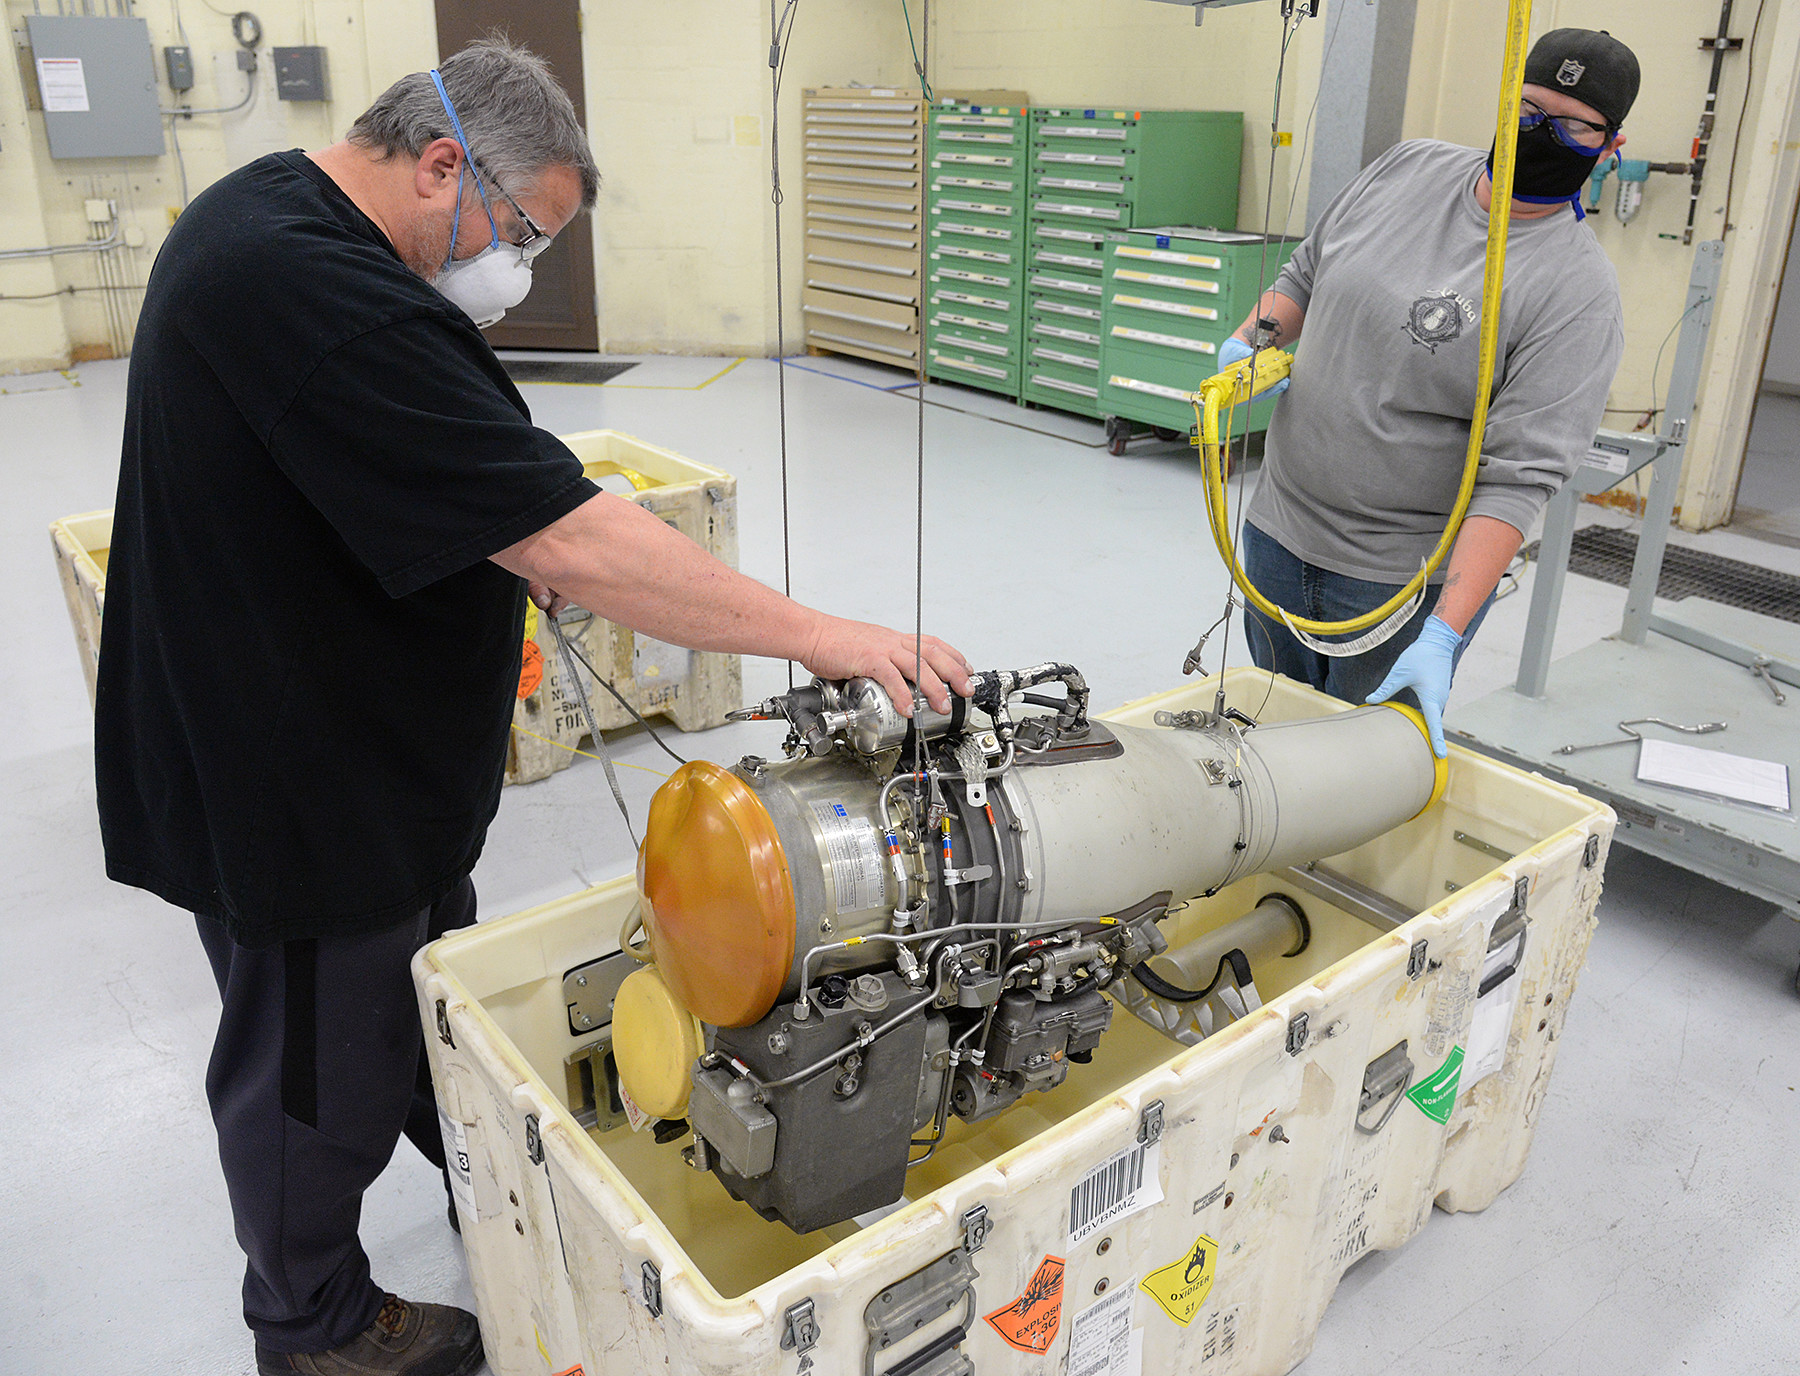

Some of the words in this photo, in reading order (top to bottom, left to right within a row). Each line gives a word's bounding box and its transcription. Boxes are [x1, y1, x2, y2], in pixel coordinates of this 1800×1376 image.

[648, 684, 680, 706] LIFT
[459, 1154, 470, 1170] 3
[1073, 1194, 1137, 1242] UBVBNMZ
[1170, 1275, 1210, 1302] OXIDIZER
[1016, 1302, 1062, 1339] EXPLOSI
